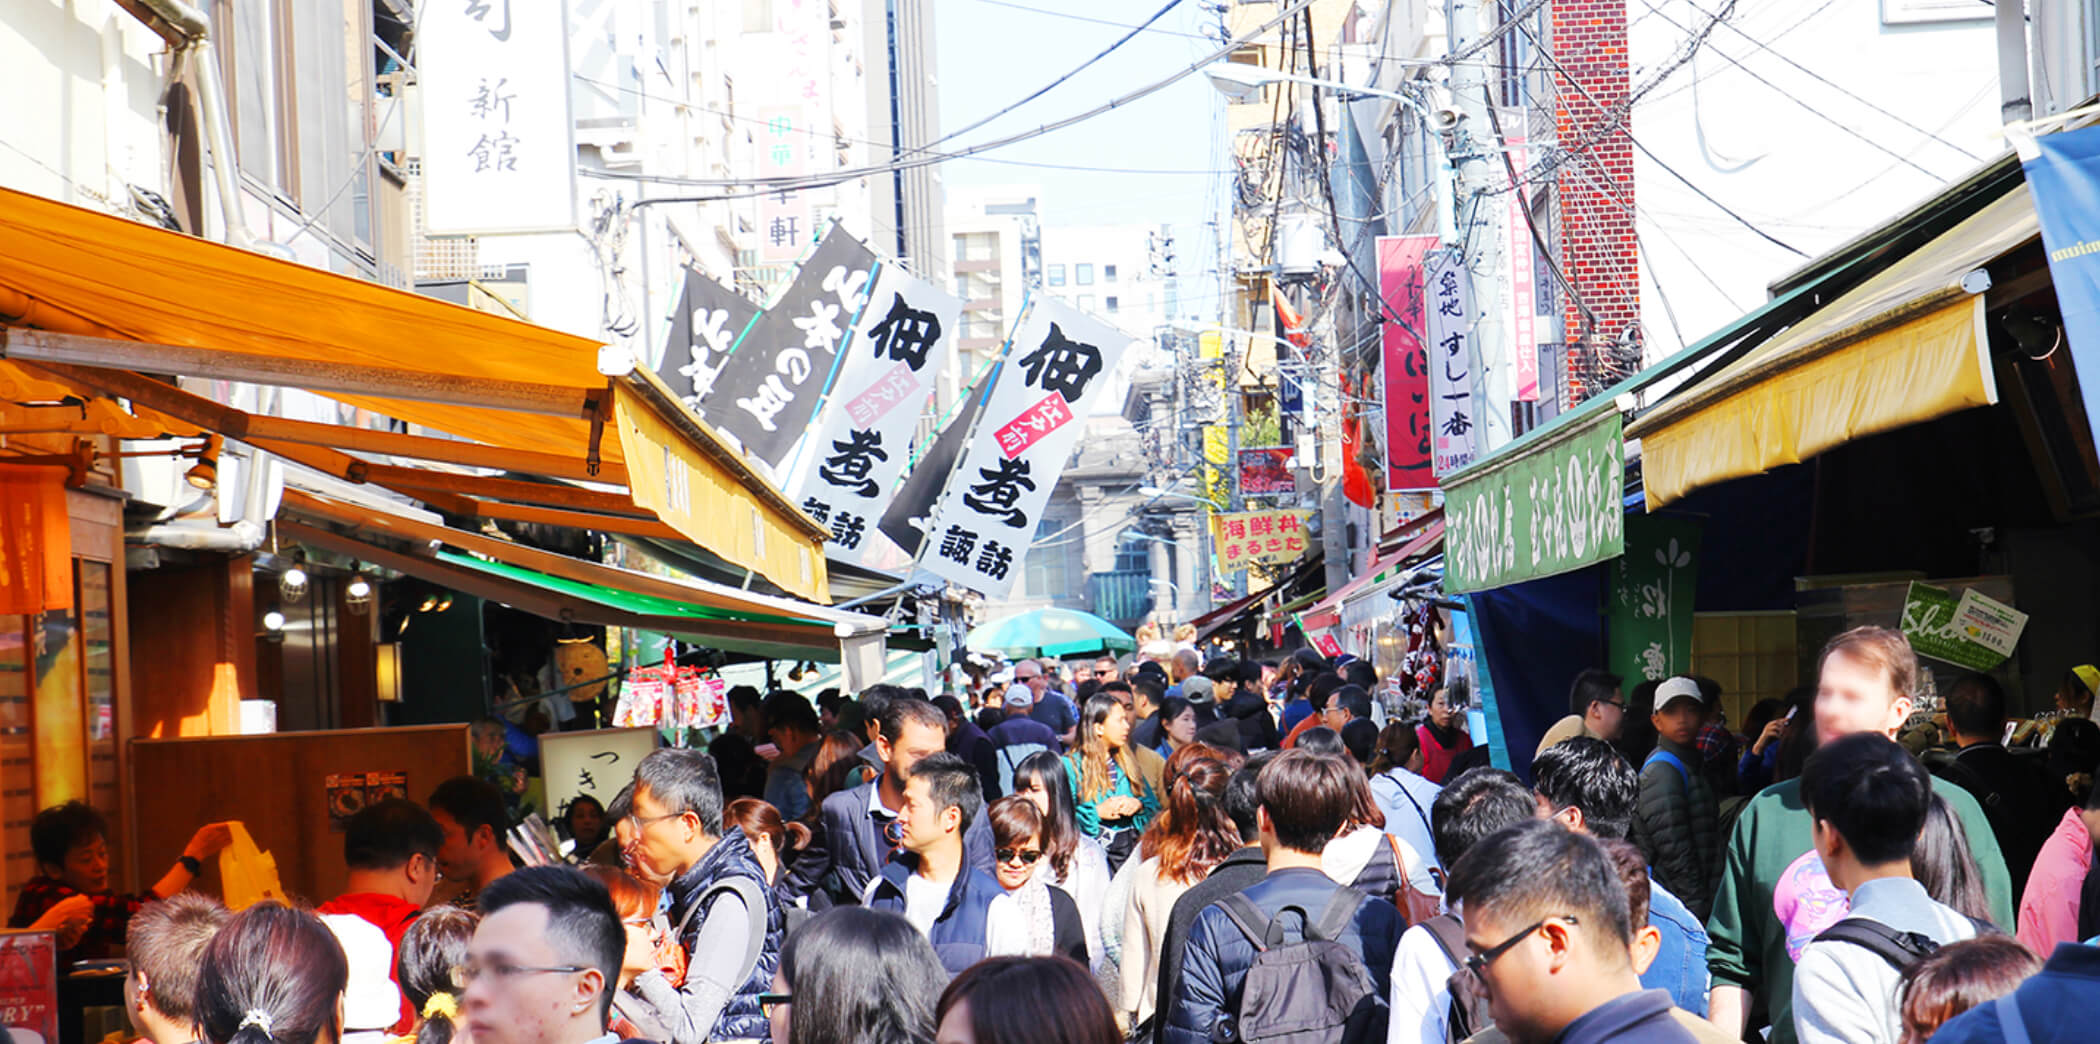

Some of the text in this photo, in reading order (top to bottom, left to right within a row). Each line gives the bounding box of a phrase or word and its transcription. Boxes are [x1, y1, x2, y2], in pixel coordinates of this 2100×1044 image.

[467, 78, 520, 173] 新館
[768, 116, 800, 247] 中華軒
[735, 265, 872, 432] 山本の豆
[1439, 270, 1473, 438] 築地 すし一番
[851, 368, 915, 426] 江戸前
[1001, 395, 1065, 453] 江戸前
[939, 524, 1014, 581] 諏訪
[1223, 514, 1301, 540] 海鮮丼
[1226, 537, 1303, 560] まるきた
